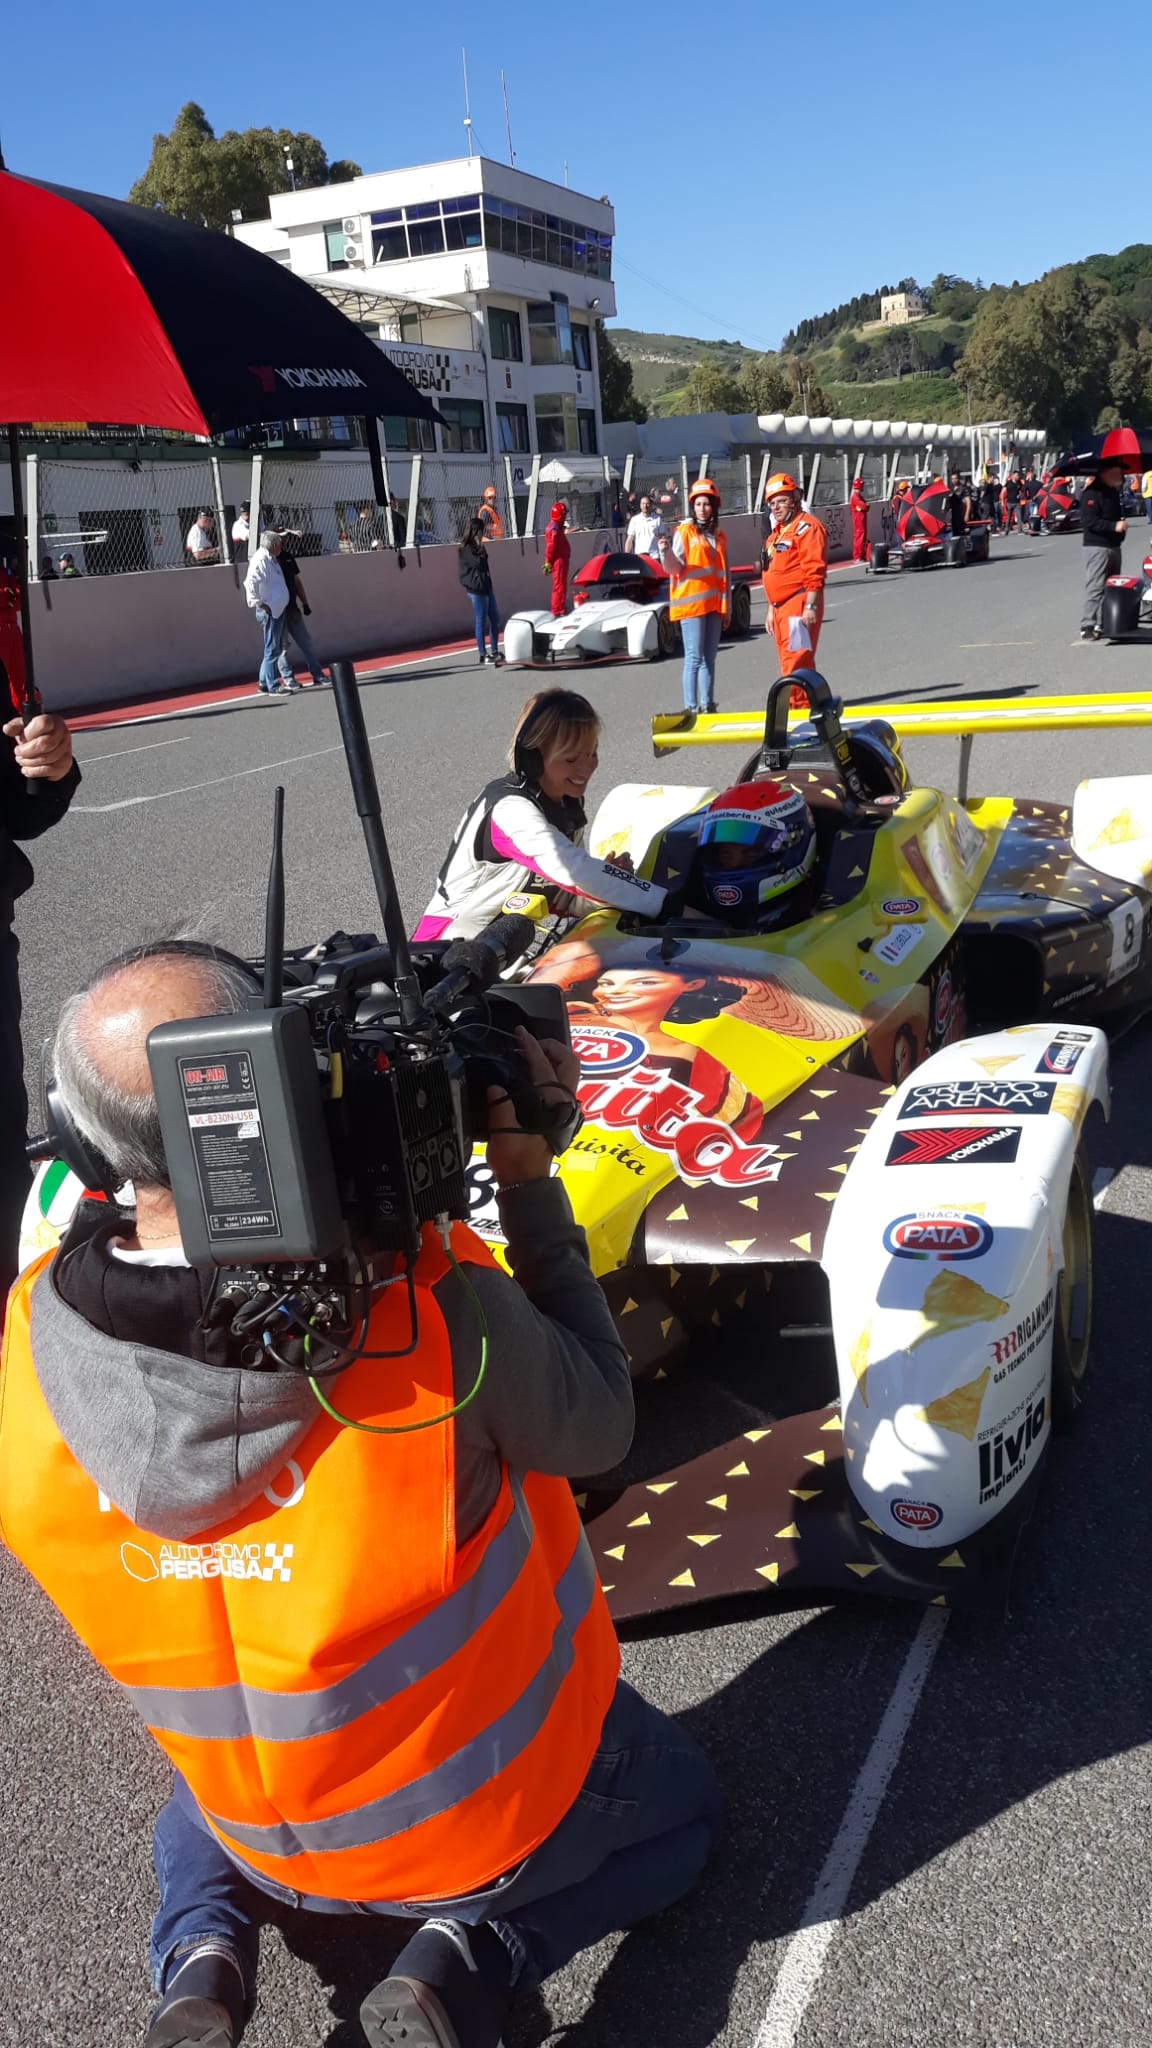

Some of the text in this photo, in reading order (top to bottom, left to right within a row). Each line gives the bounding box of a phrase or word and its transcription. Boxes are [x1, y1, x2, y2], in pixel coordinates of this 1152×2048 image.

[275, 368, 367, 388] YOKOHAMA
[601, 864, 652, 892] sparco
[1122, 912, 1135, 955] 8
[570, 1026, 615, 1038] NACK
[573, 1036, 610, 1059] TA
[186, 1068, 225, 1085] ON-AIR
[912, 1080, 1041, 1098] GRUPPO
[905, 1091, 1033, 1112] ARENA
[947, 1127, 1018, 1162] YOKOHAMA
[242, 1215, 269, 1225] 234Wh
[918, 1211, 963, 1220] SNACK
[904, 1226, 969, 1245] PATA
[993, 1368, 1006, 1384] GAS
[978, 1396, 1045, 1491] livio
[979, 1453, 1026, 1504] impianti
[900, 1506, 931, 1521] PATA
[159, 1543, 261, 1560] AUTODROMO
[160, 1559, 265, 1580] PERGUSA
